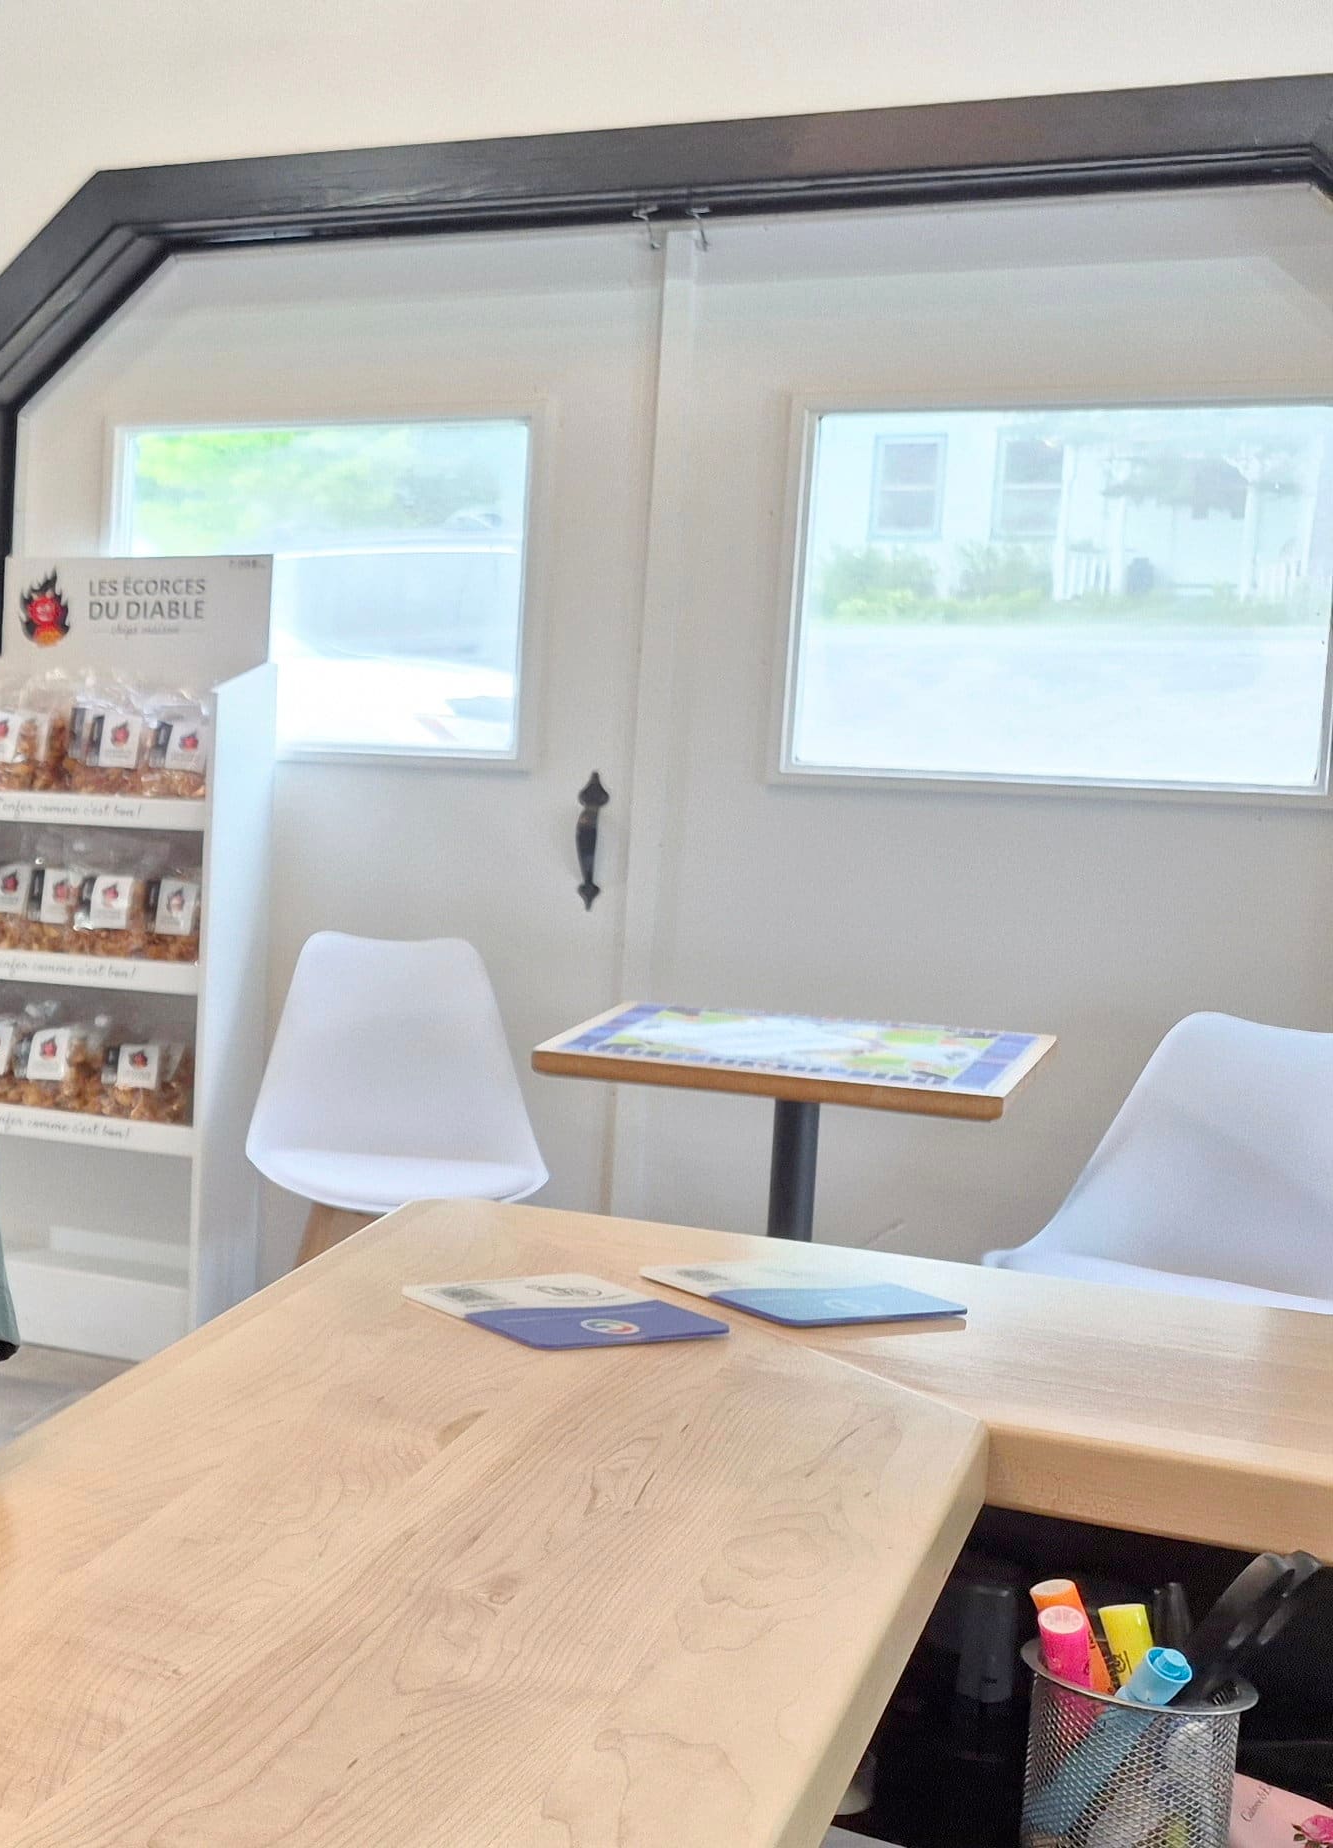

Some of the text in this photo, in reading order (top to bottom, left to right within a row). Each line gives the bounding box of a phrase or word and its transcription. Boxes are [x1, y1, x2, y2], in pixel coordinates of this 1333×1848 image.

[88, 575, 207, 596] LES ÉCORCES
[88, 599, 206, 620] DU DIABLE
